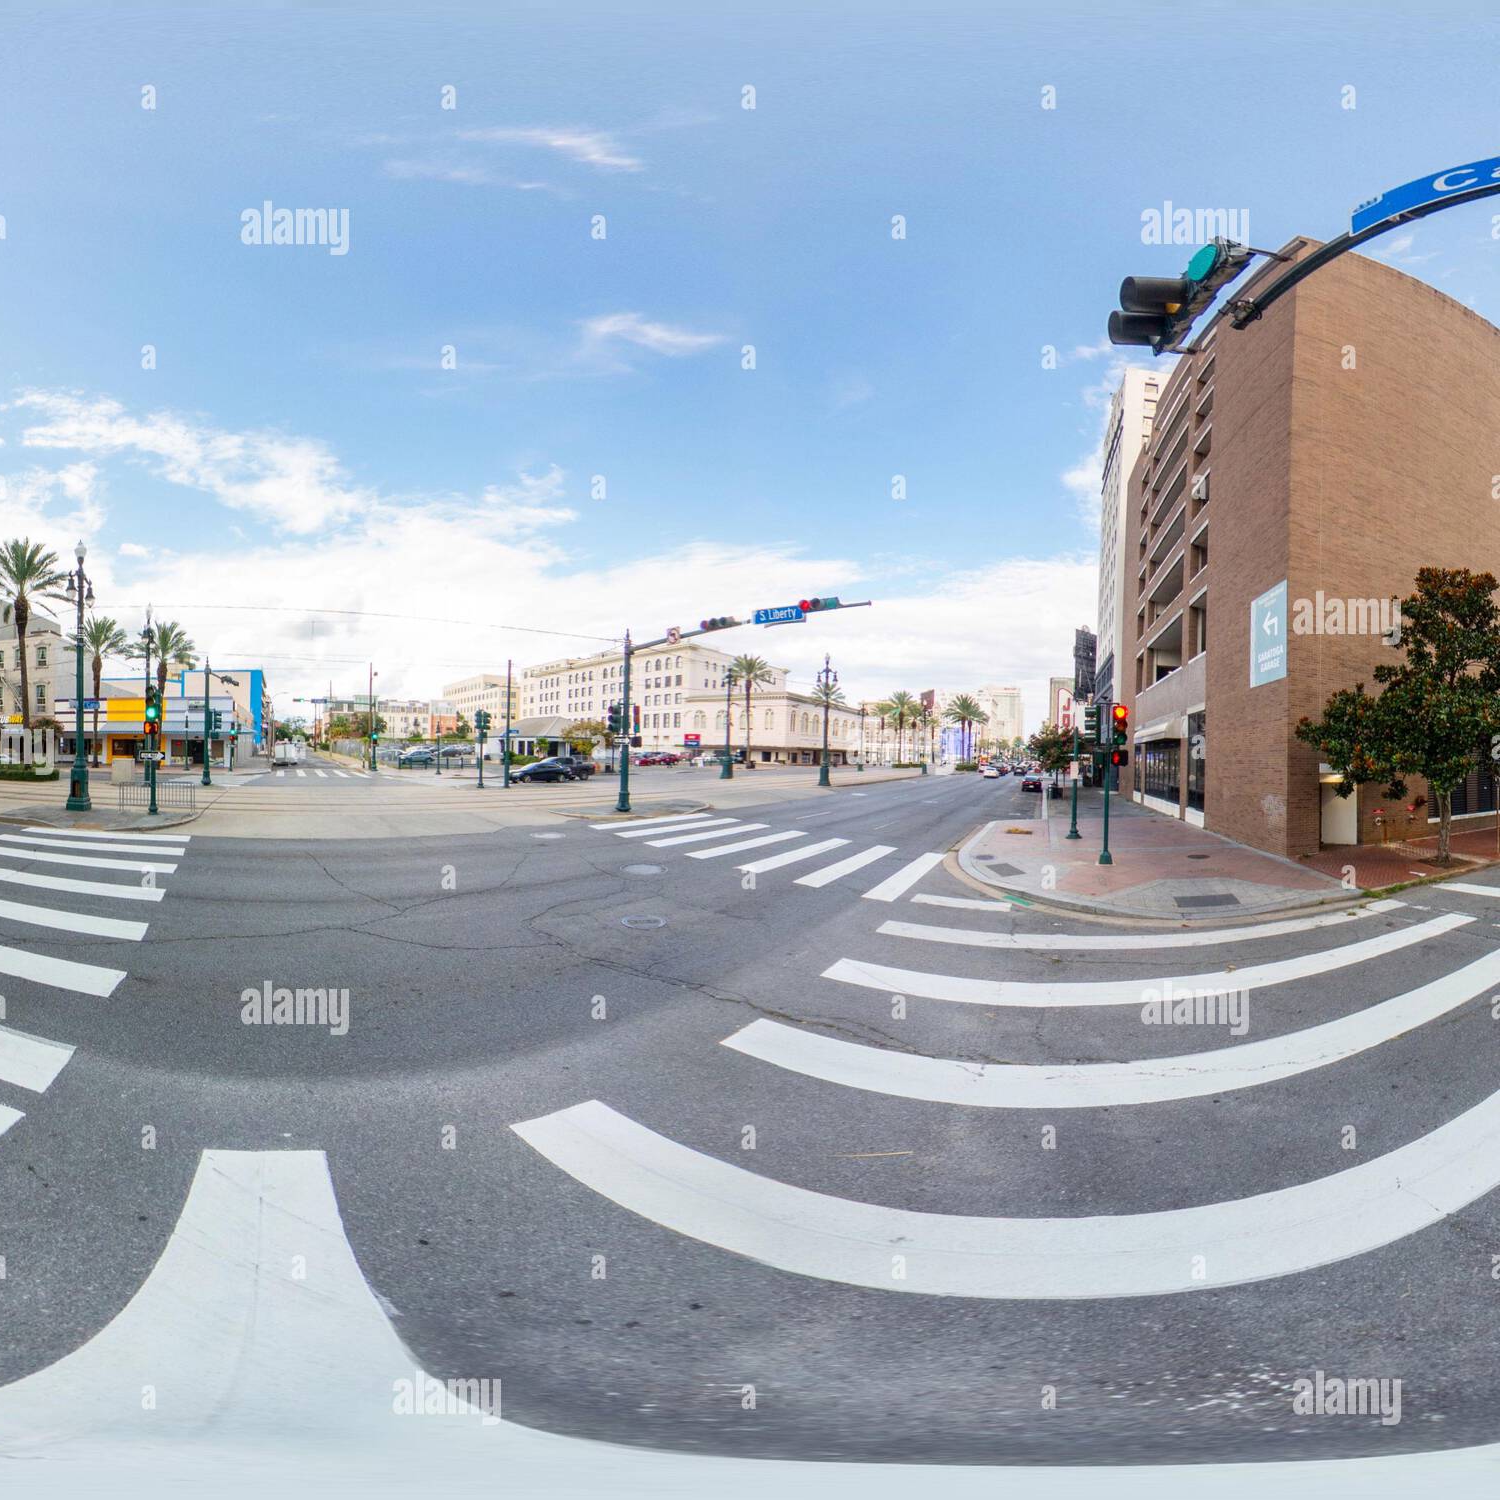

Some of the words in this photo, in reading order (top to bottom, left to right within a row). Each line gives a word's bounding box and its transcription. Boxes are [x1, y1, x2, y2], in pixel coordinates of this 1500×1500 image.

[768, 606, 797, 620] Liberty
[1257, 644, 1284, 663] SARATOGA
[1260, 657, 1281, 673] GARAGE
